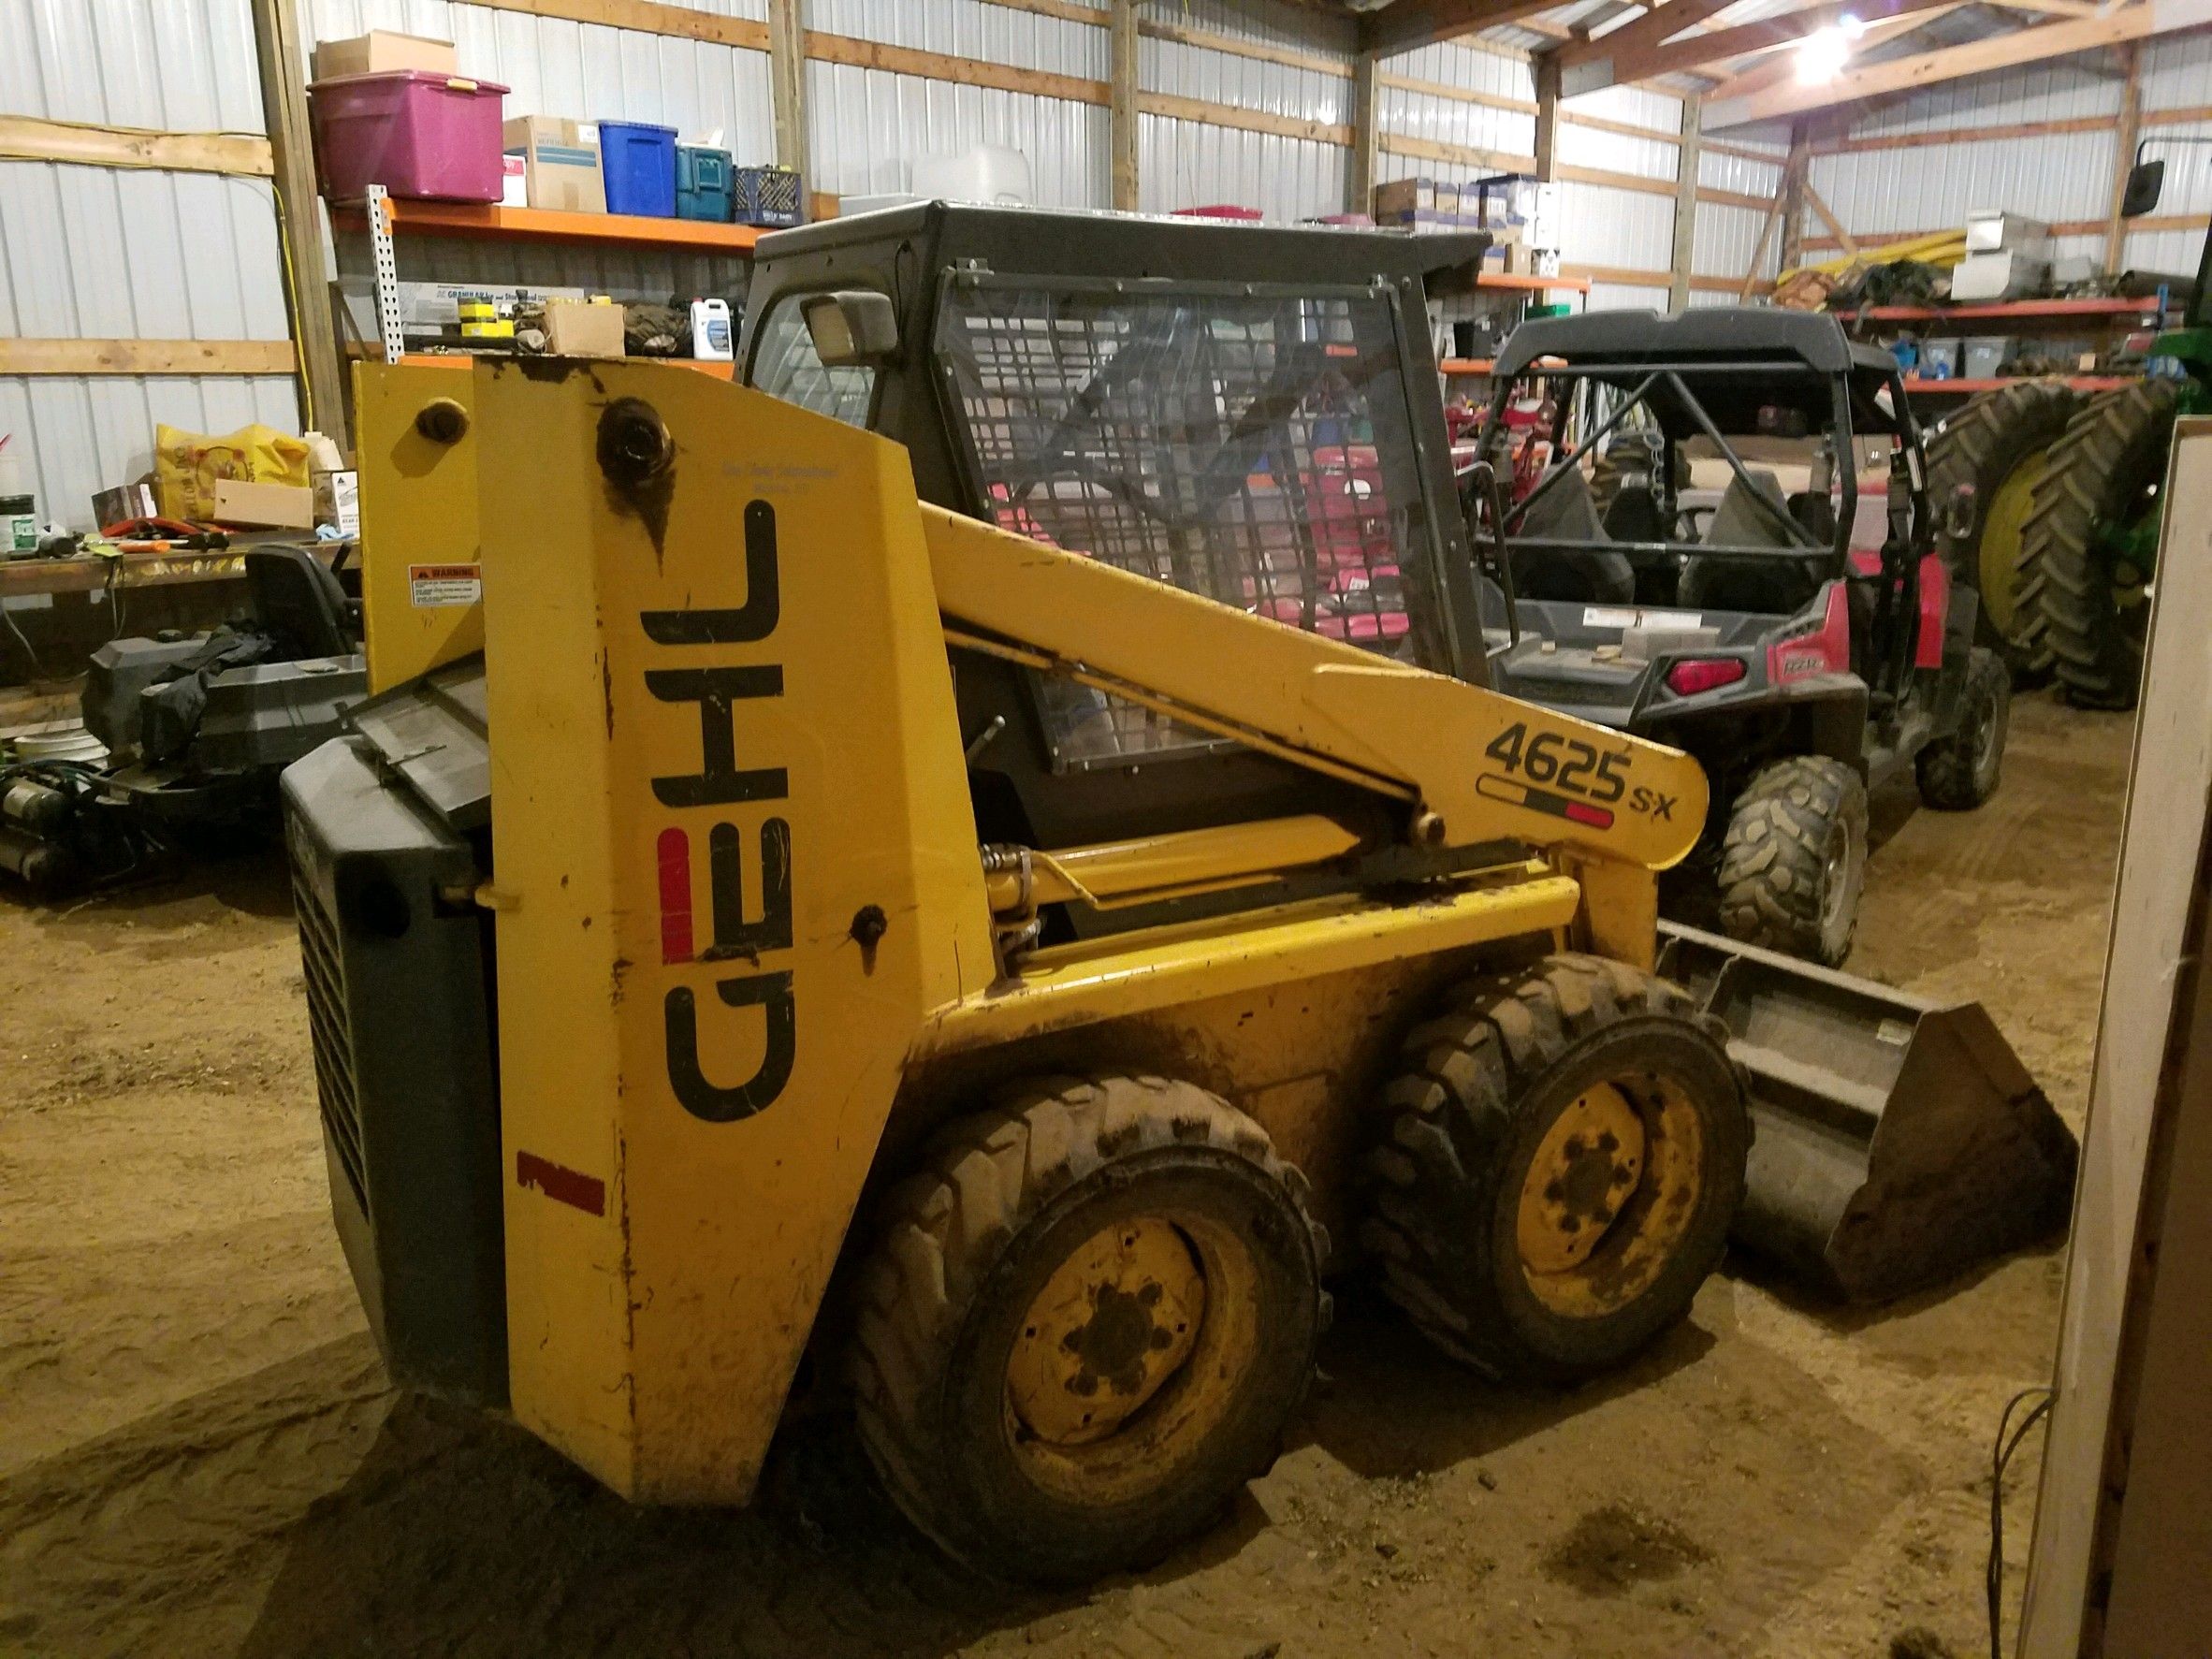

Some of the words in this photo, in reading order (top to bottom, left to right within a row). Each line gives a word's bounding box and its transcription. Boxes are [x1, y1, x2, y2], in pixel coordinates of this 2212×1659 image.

[432, 567, 474, 577] WARNING
[1485, 721, 1632, 803] 4625
[640, 499, 795, 1123] GEHL
